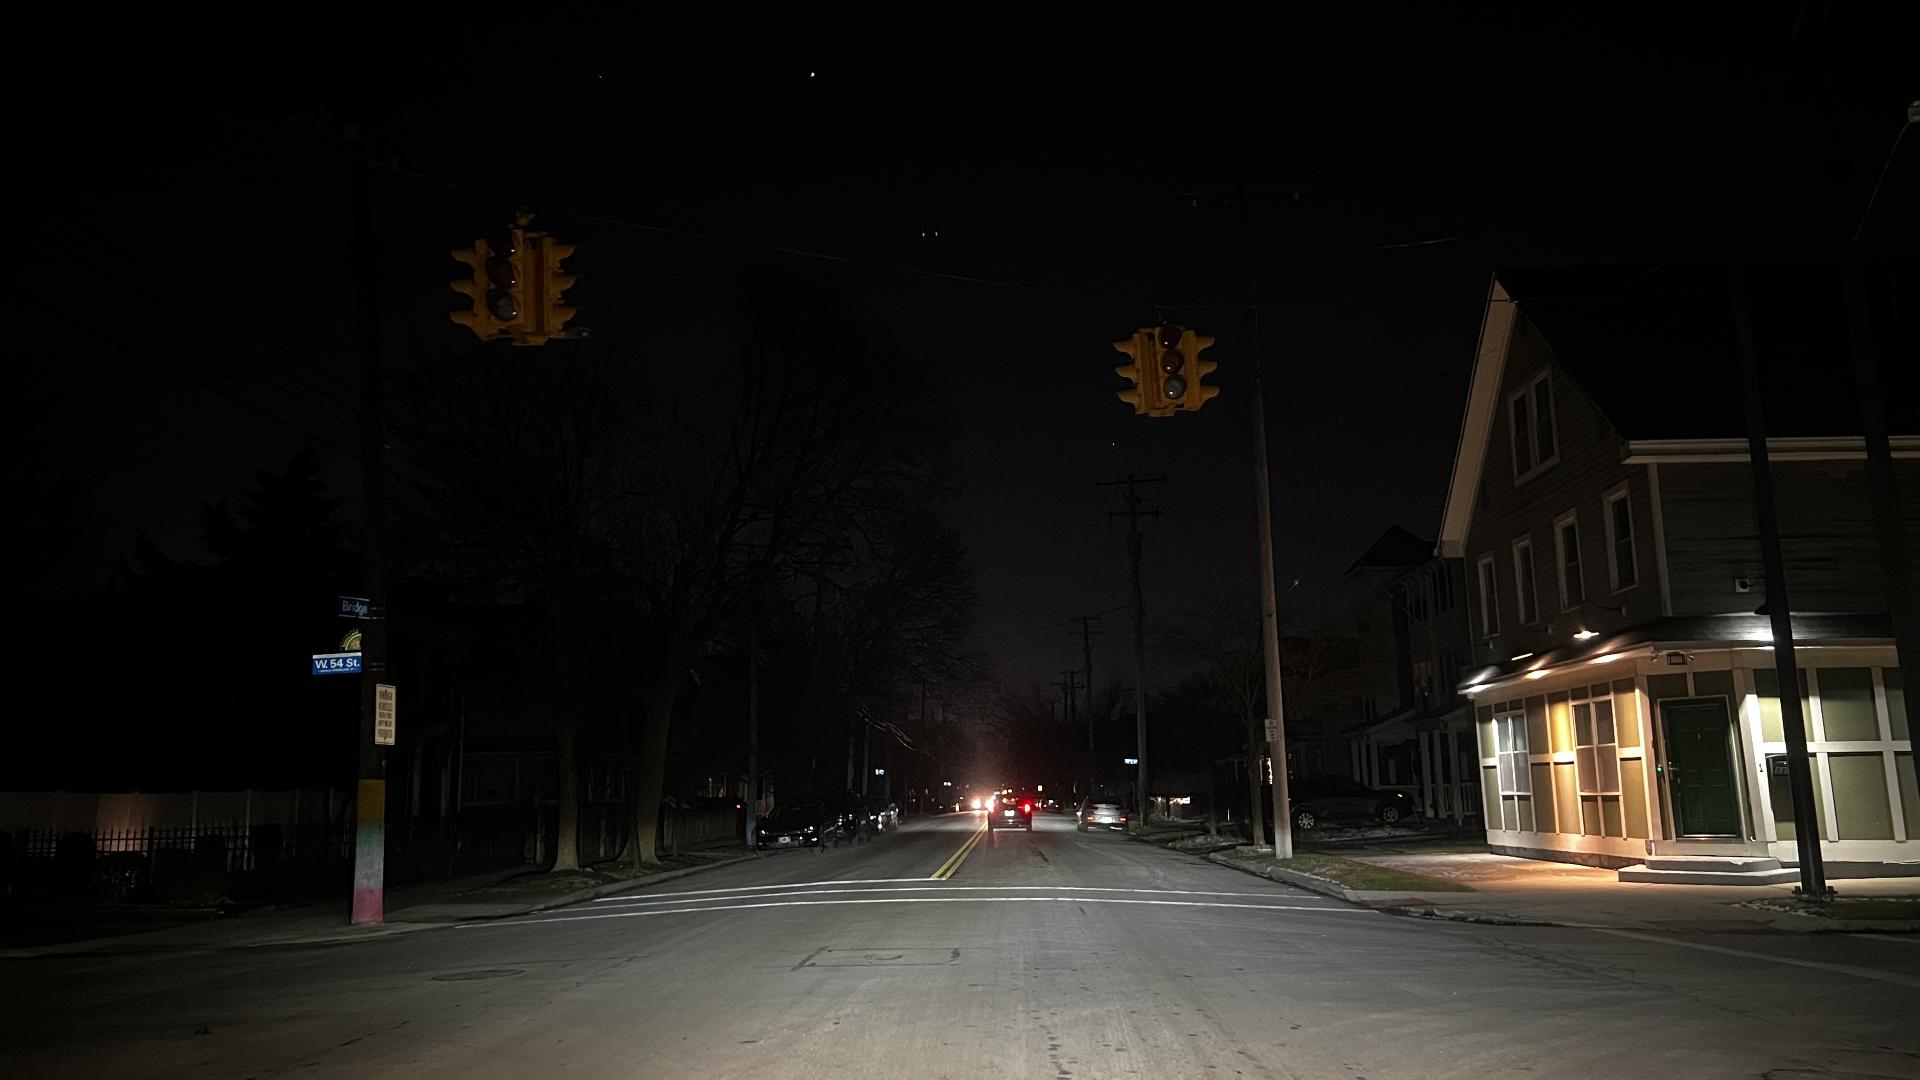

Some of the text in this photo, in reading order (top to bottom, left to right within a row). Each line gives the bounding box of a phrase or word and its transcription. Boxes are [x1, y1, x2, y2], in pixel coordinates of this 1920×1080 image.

[342, 600, 368, 616] Bridge
[314, 657, 360, 669] W. 54 St.
